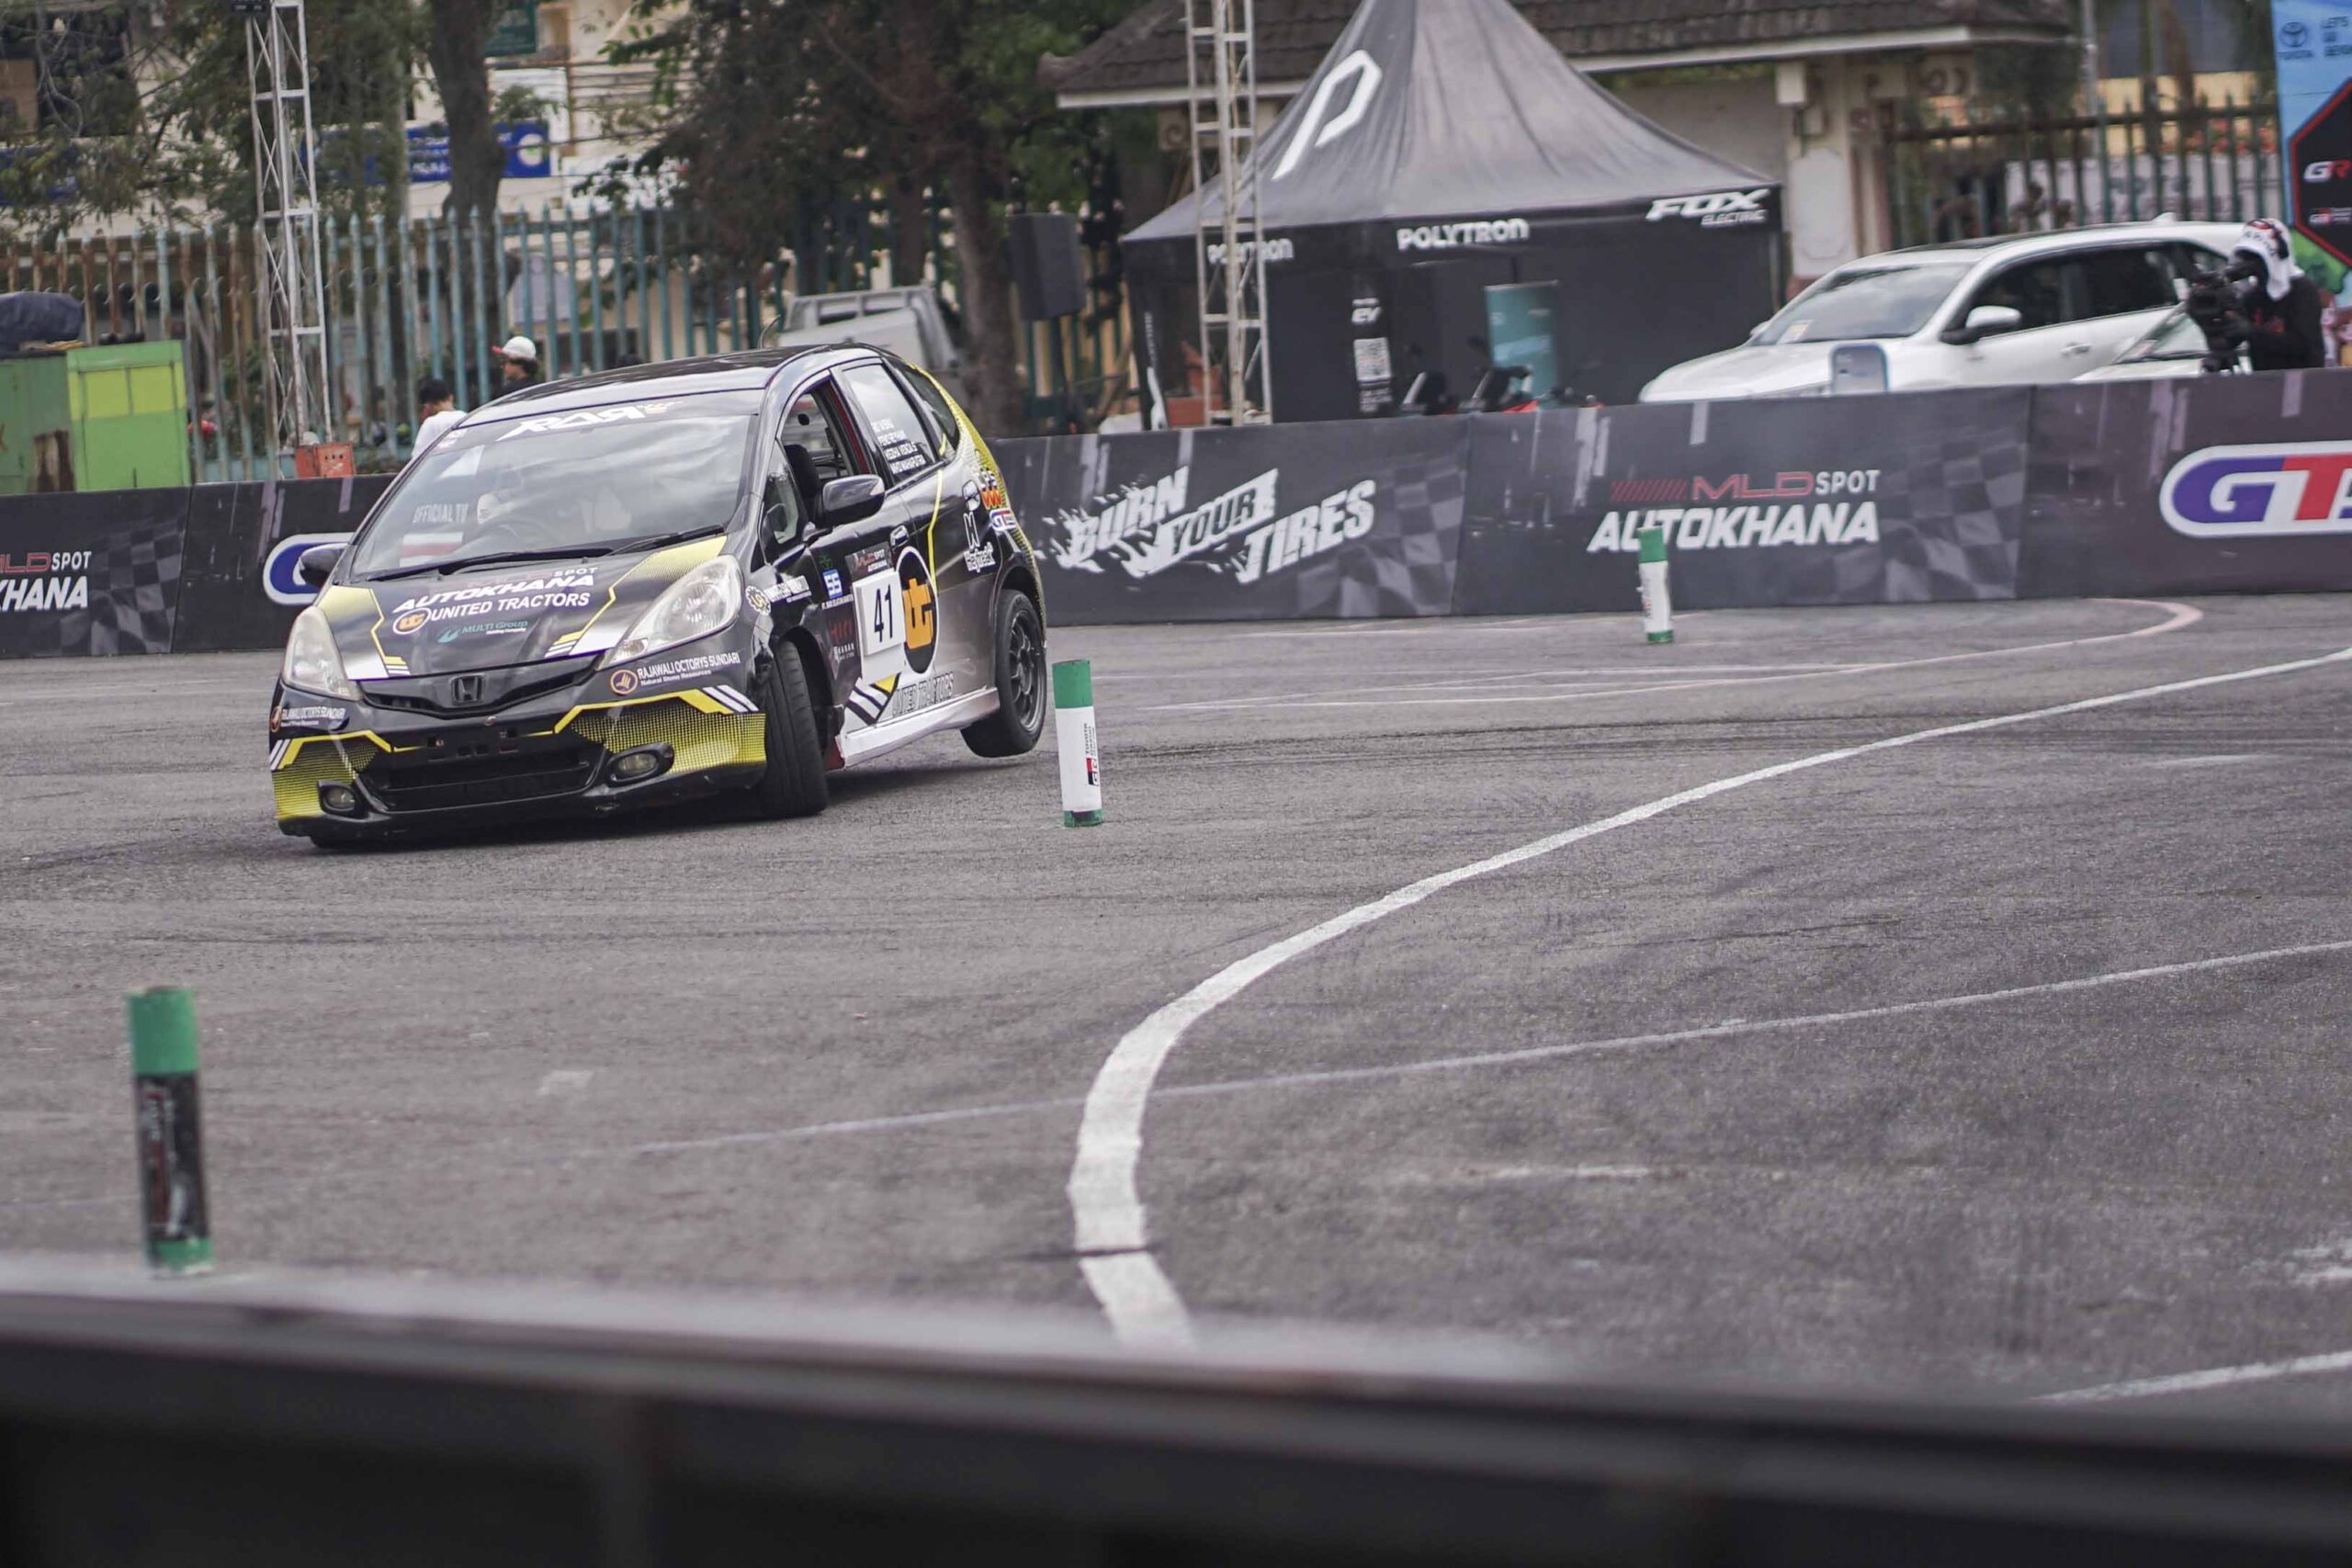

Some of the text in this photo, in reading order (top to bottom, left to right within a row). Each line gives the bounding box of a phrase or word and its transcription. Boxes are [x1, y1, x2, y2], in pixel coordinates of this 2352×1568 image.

[1645, 188, 1770, 221] FOX
[1396, 218, 1530, 251] POLYTRON
[1061, 466, 1189, 570] BURN
[1123, 468, 1278, 578] YOUR
[1236, 479, 1375, 584] TIRES
[1587, 502, 1880, 552] AUTOKHANA
[392, 574, 594, 614] AUTOKHANA
[430, 592, 591, 622] UNITED TRACTORS
[874, 583, 893, 643] 41
[637, 651, 741, 680] RAJAWALI OCTORYS SUNDARI
